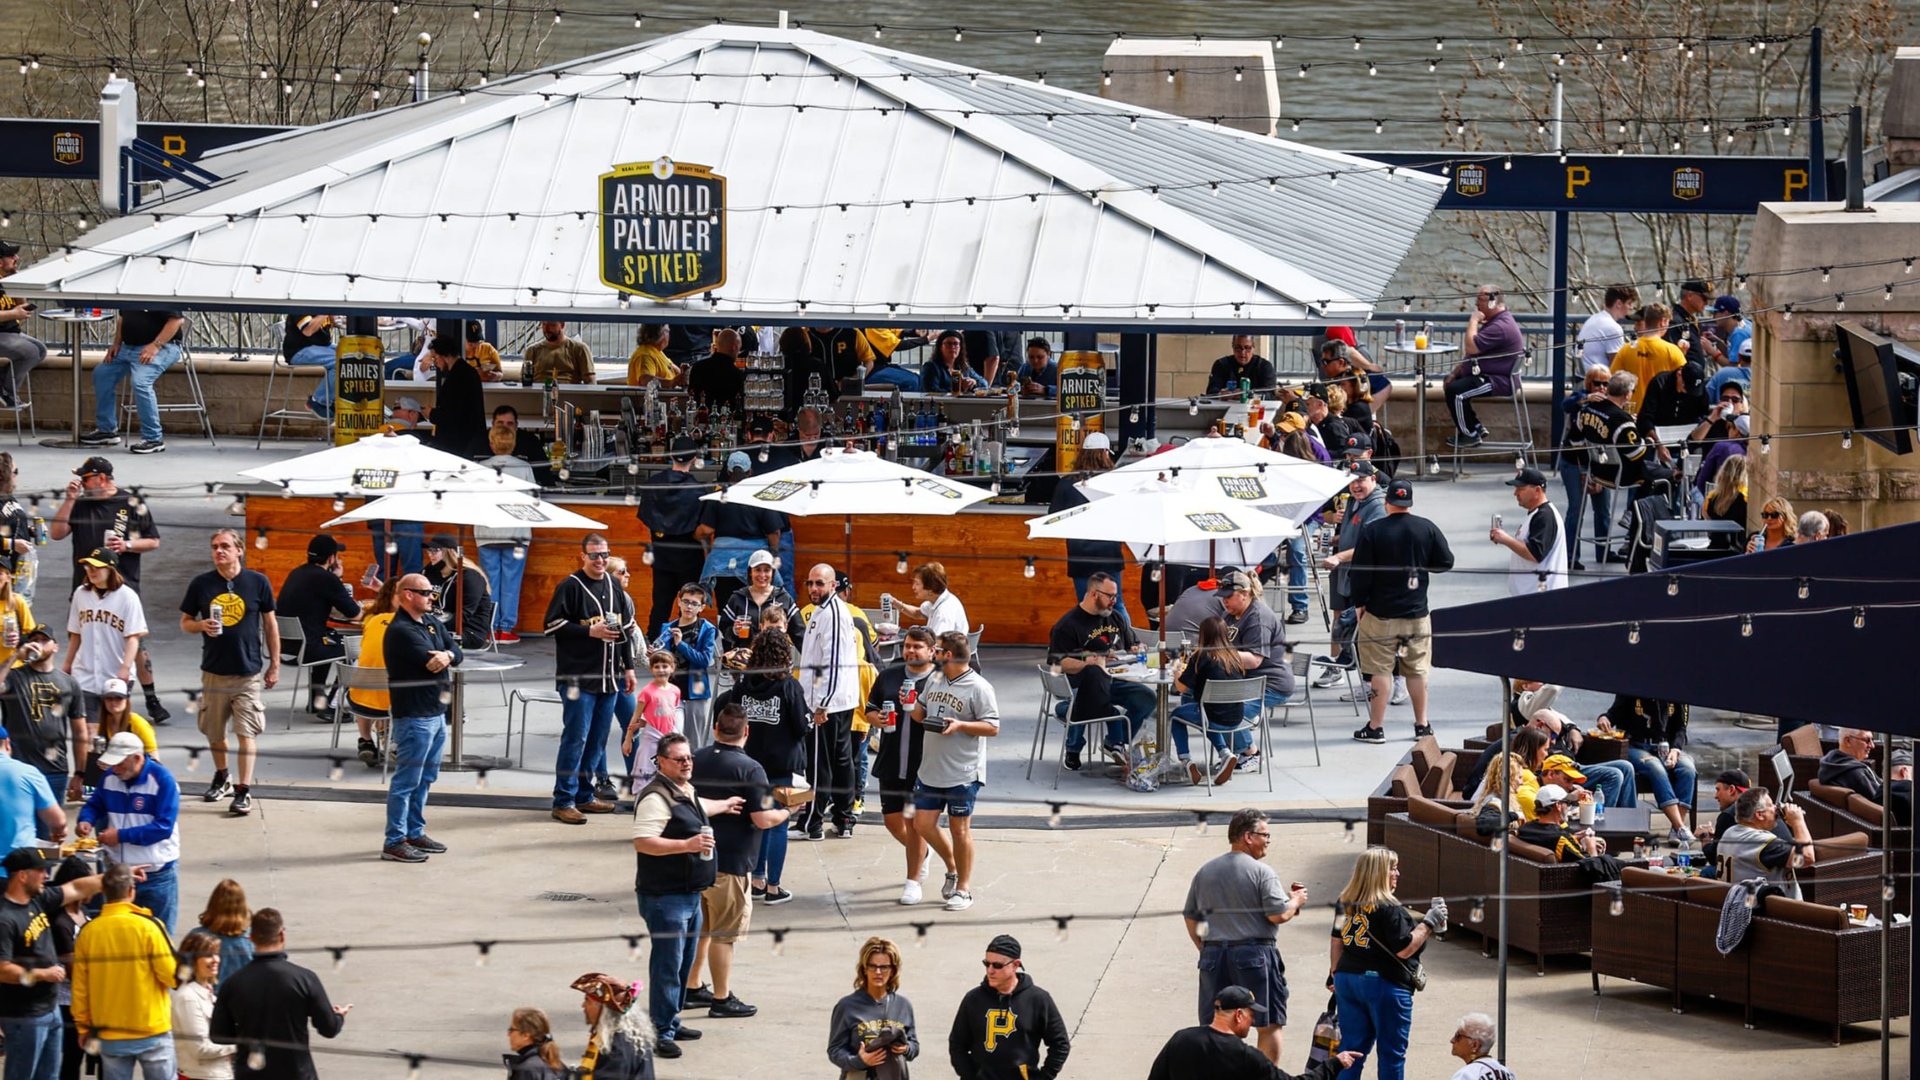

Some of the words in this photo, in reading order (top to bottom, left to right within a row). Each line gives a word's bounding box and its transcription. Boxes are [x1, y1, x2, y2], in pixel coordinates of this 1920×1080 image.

[57, 145, 79, 153] PALMER
[1460, 177, 1482, 185] PALMER
[1567, 166, 1590, 198] P
[1676, 180, 1699, 188] PALMER
[1784, 169, 1807, 200] P
[613, 184, 710, 216] ARNOLD
[614, 219, 711, 251] PALMER
[624, 252, 700, 285] SPIKED
[837, 342, 846, 353] P
[340, 363, 379, 379] ARNIE'S
[344, 380, 375, 393] SPIKED
[1062, 379, 1101, 394] ARNIE'S
[1066, 395, 1096, 409] SPIKED
[338, 413, 380, 430] LEMONADE
[1222, 477, 1258, 486] ARNOLD
[1225, 484, 1260, 492] PALMER
[79, 609, 125, 632] PIRATES
[31, 682, 60, 722] P
[927, 691, 964, 712] PIRATES
[984, 1007, 1018, 1053] P
